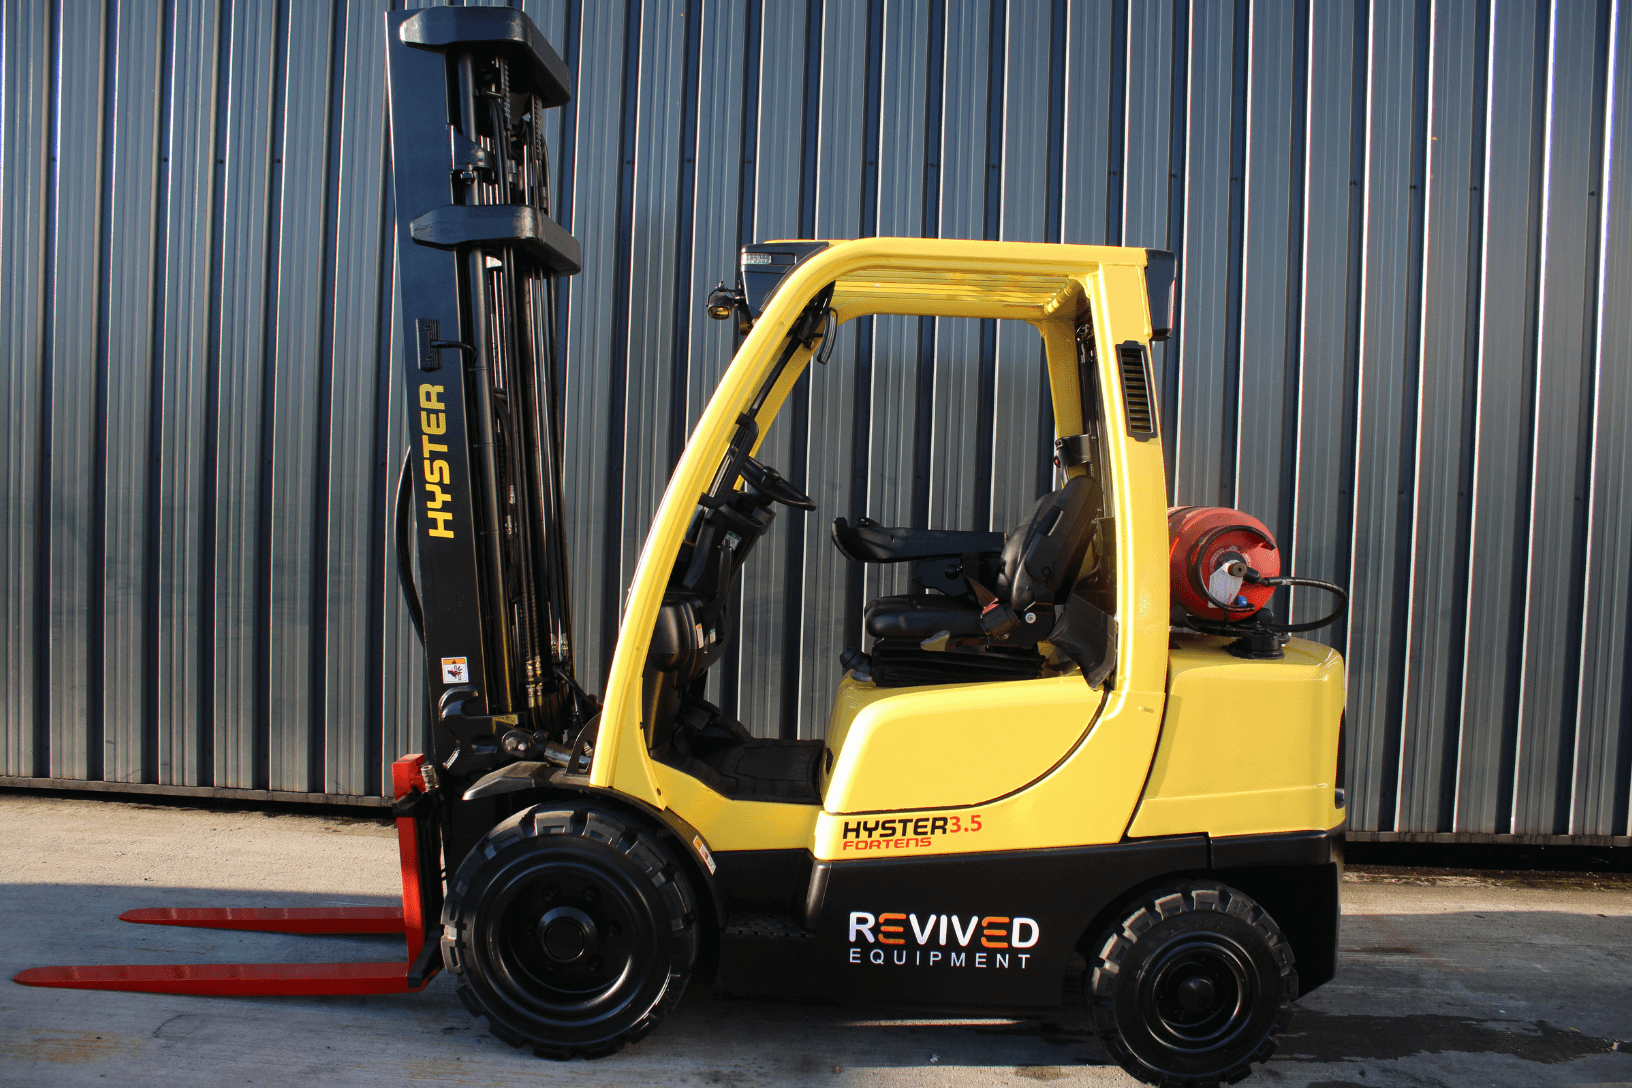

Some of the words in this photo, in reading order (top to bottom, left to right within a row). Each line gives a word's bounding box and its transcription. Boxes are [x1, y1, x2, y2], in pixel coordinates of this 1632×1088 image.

[420, 384, 454, 538] HYSTER
[843, 817, 948, 839] HYSTER
[949, 814, 982, 833] 3.5
[843, 837, 932, 851] FORTENS
[849, 911, 1040, 948] REVIVED
[849, 948, 1030, 969] EQUIPMENT
